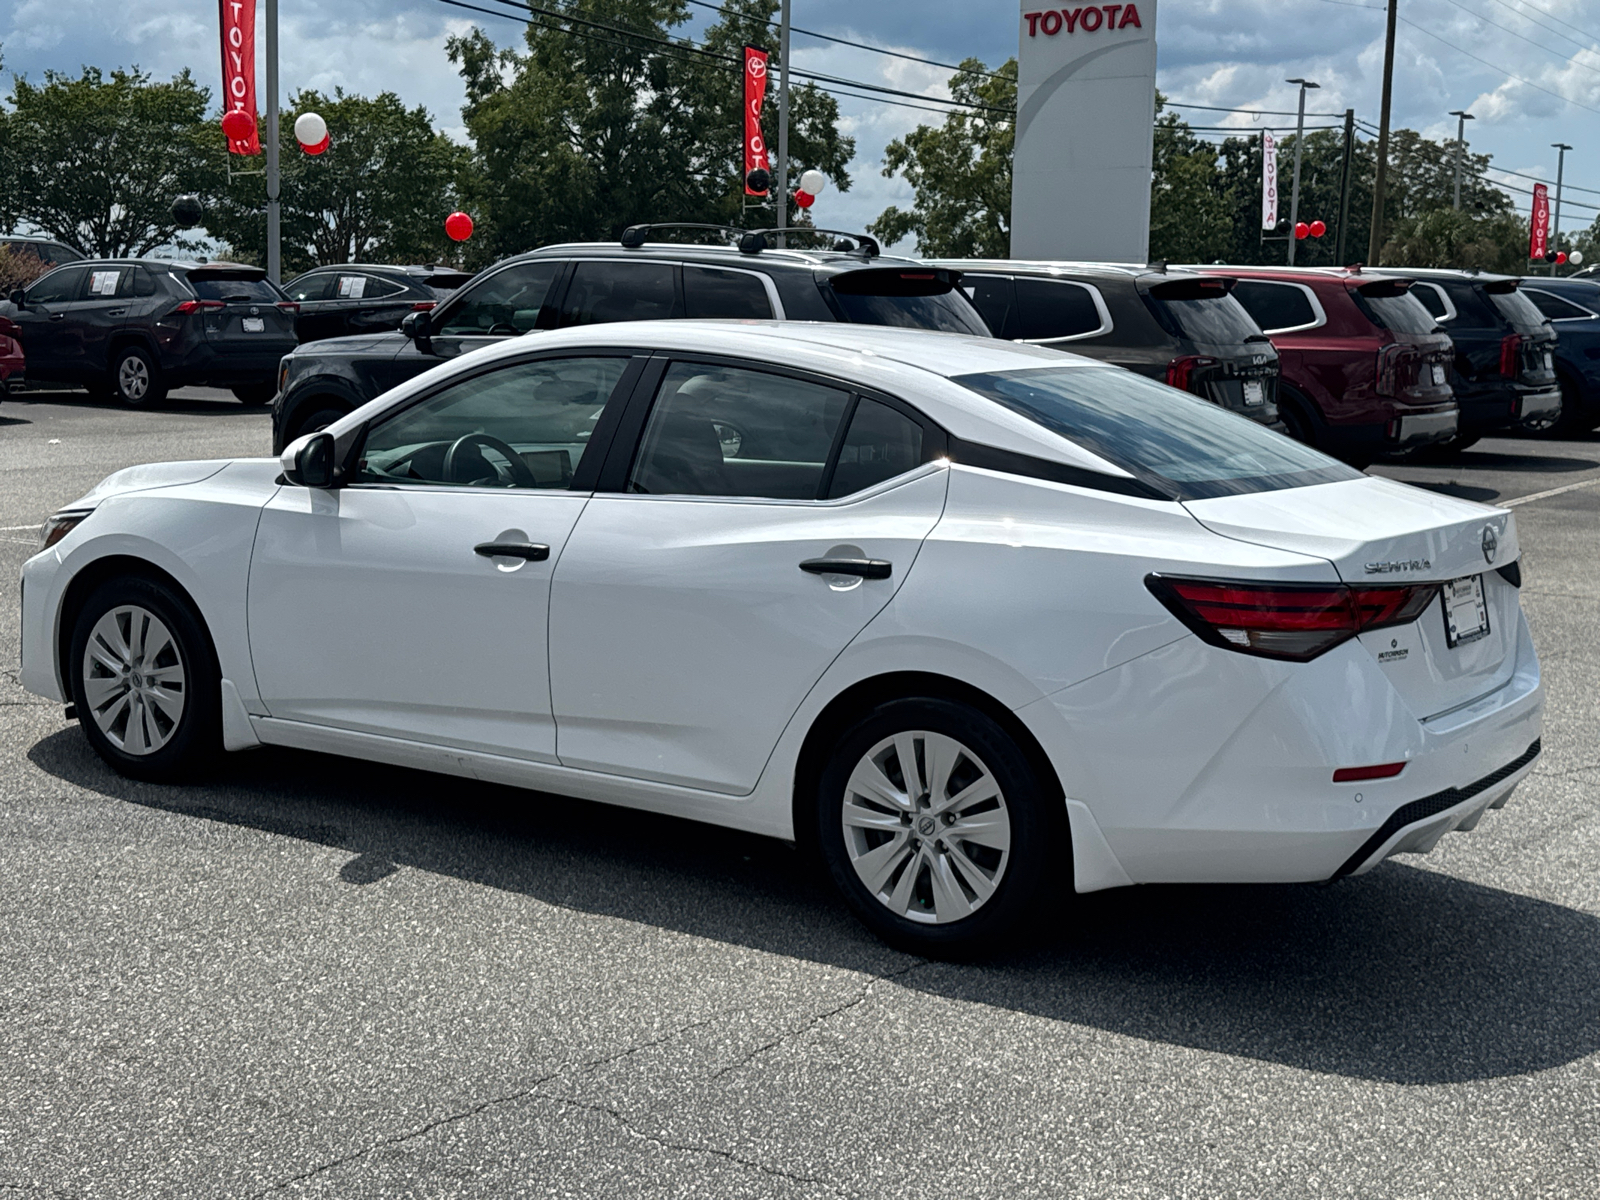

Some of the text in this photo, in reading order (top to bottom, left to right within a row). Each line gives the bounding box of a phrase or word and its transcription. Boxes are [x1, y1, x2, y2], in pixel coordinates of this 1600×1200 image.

[1024, 3, 1141, 37] TOYOTA
[229, 1, 249, 148] TOYOT
[1266, 151, 1276, 222] TOYOTA
[1534, 200, 1547, 257] TOYOTA
[1364, 558, 1432, 574] SENTRA
